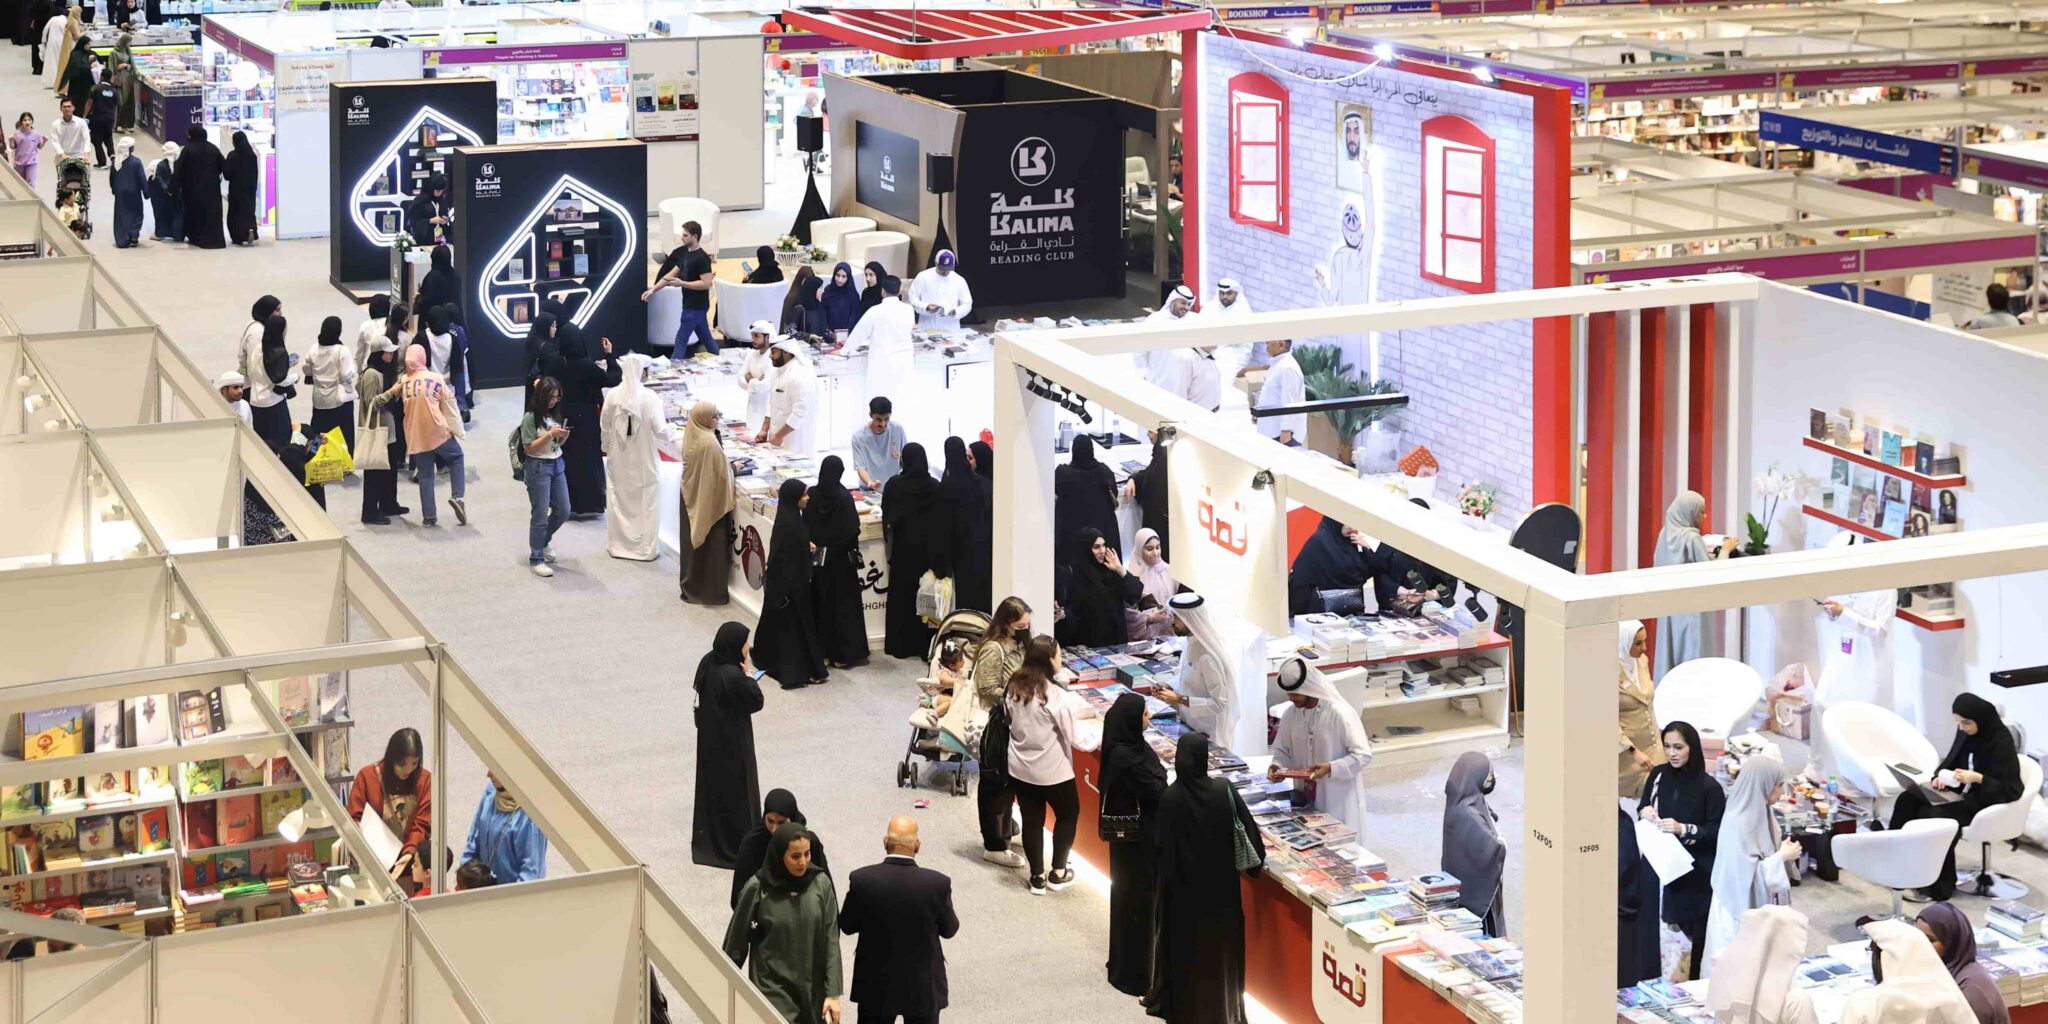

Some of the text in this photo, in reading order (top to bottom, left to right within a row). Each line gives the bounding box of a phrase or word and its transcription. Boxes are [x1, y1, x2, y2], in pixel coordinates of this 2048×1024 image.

[1229, 9, 1268, 18] BOOKSHOP
[1354, 5, 1392, 13] BOOKSHOP
[1801, 127, 1837, 146] والتوزيع
[1838, 133, 1864, 149] للنشر
[990, 214, 1075, 236] KALIMA
[989, 235, 1075, 253] نادي القراءة
[989, 251, 1075, 265] READING CLUB
[1533, 829, 1553, 849] 12F05
[1579, 843, 1600, 854] 12F05
[1322, 940, 1367, 1008] قصة
